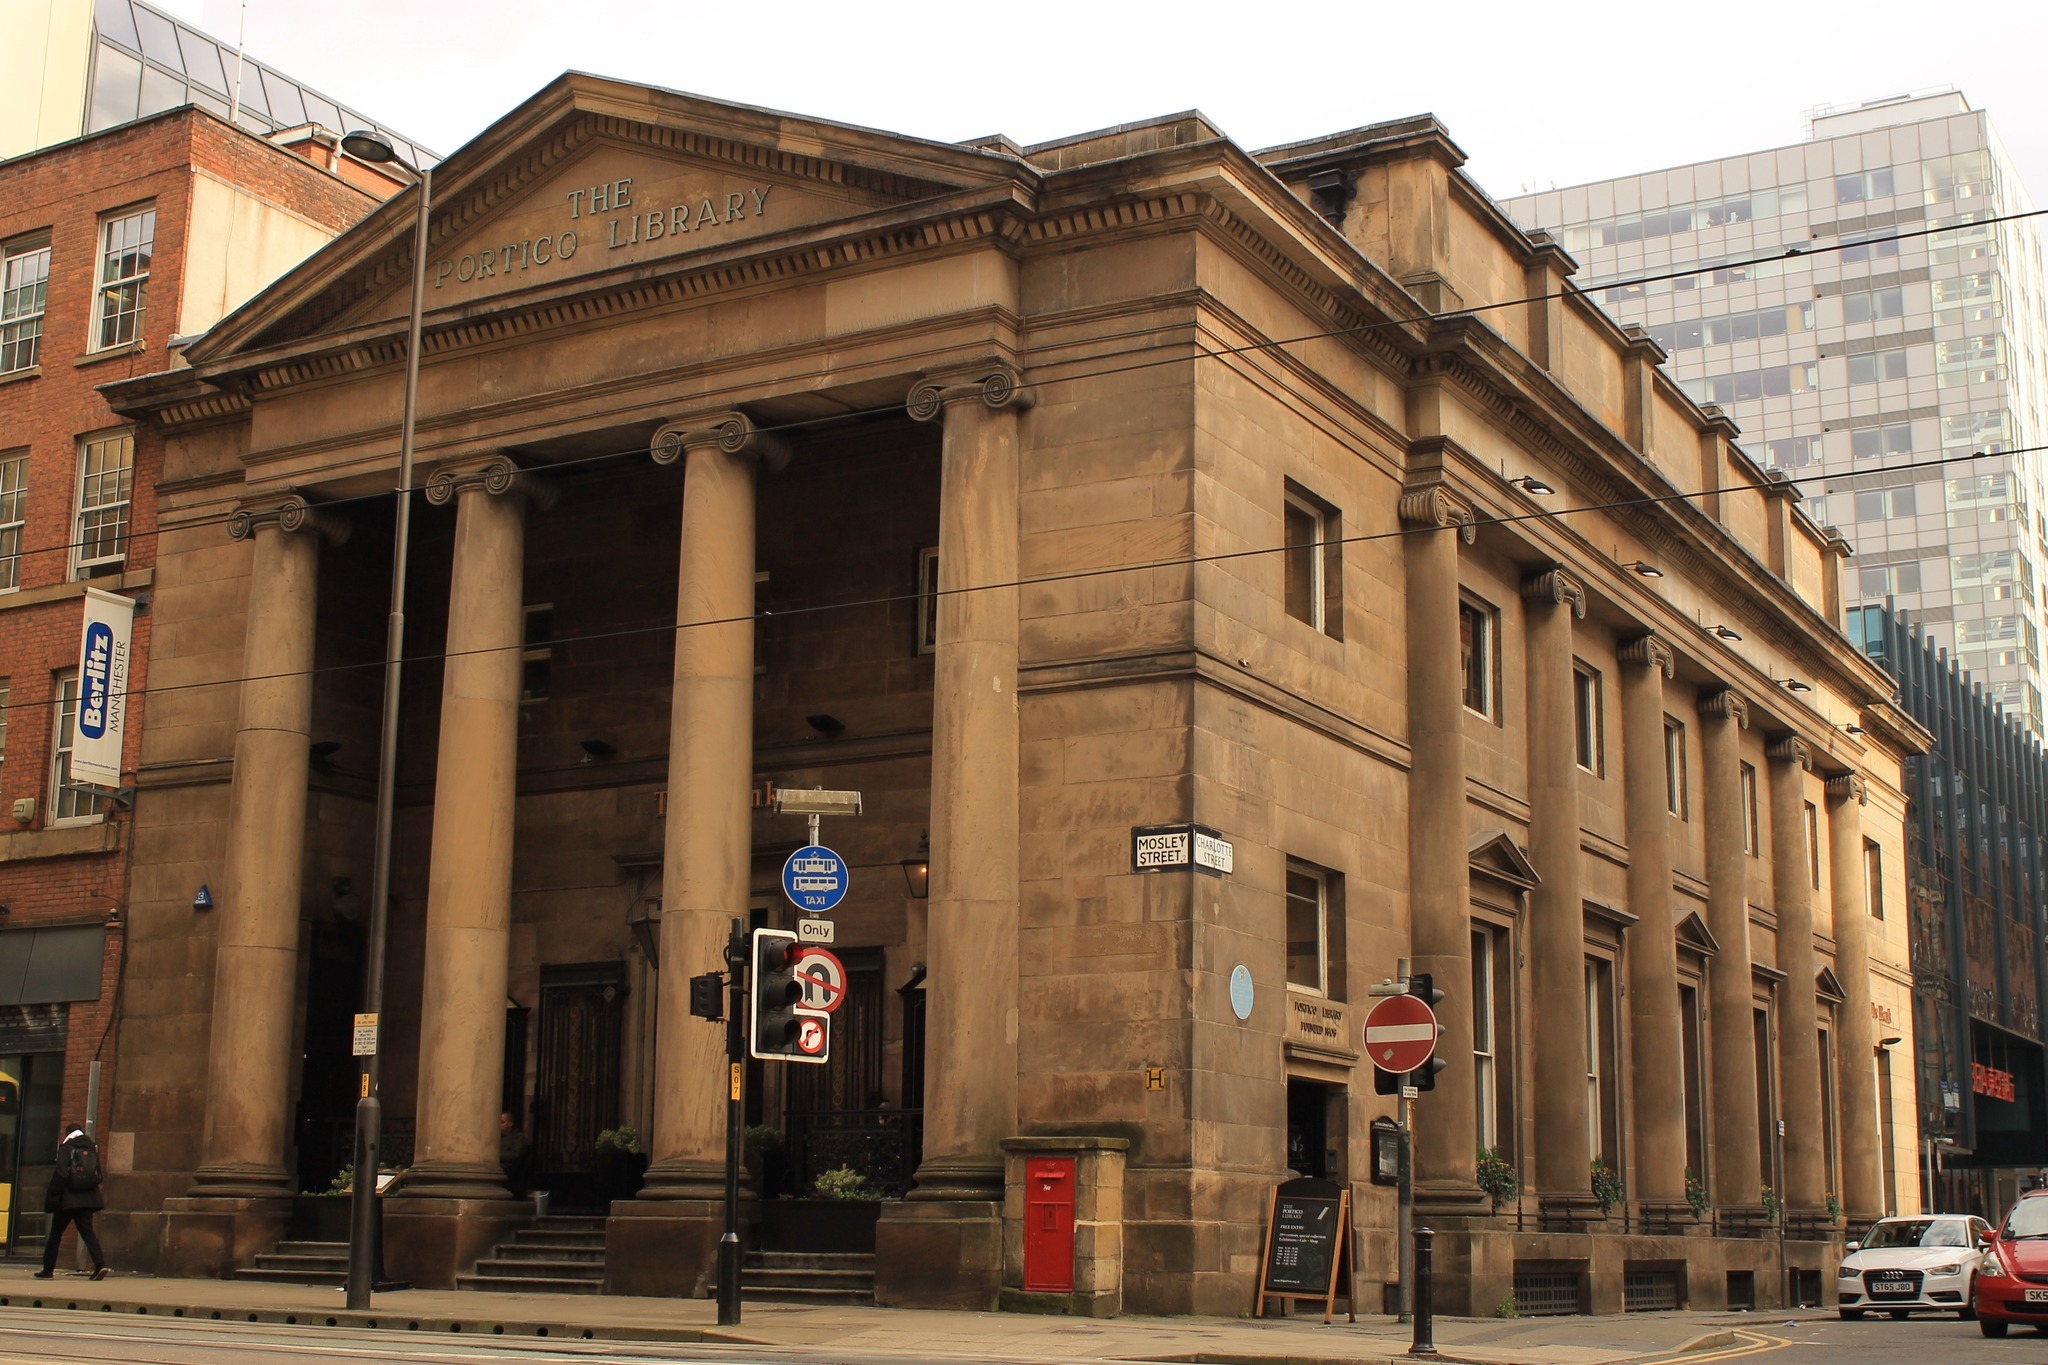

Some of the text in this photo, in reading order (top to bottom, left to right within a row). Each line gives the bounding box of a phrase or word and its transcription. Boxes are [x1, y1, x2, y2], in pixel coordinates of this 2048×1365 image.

[567, 178, 632, 219] THE
[434, 184, 773, 289] PORTICO LIBRARY
[84, 633, 109, 729] Berlitz
[109, 641, 126, 733] MANCHESTER
[1139, 835, 1186, 851] MOSLEY
[1196, 836, 1232, 857] CHARLOTTE
[1204, 852, 1225, 868] STREET
[804, 896, 825, 905] TAXI
[803, 924, 830, 938] Only
[1875, 1283, 1894, 1291] ST65
[2029, 1290, 2048, 1301] SK5
